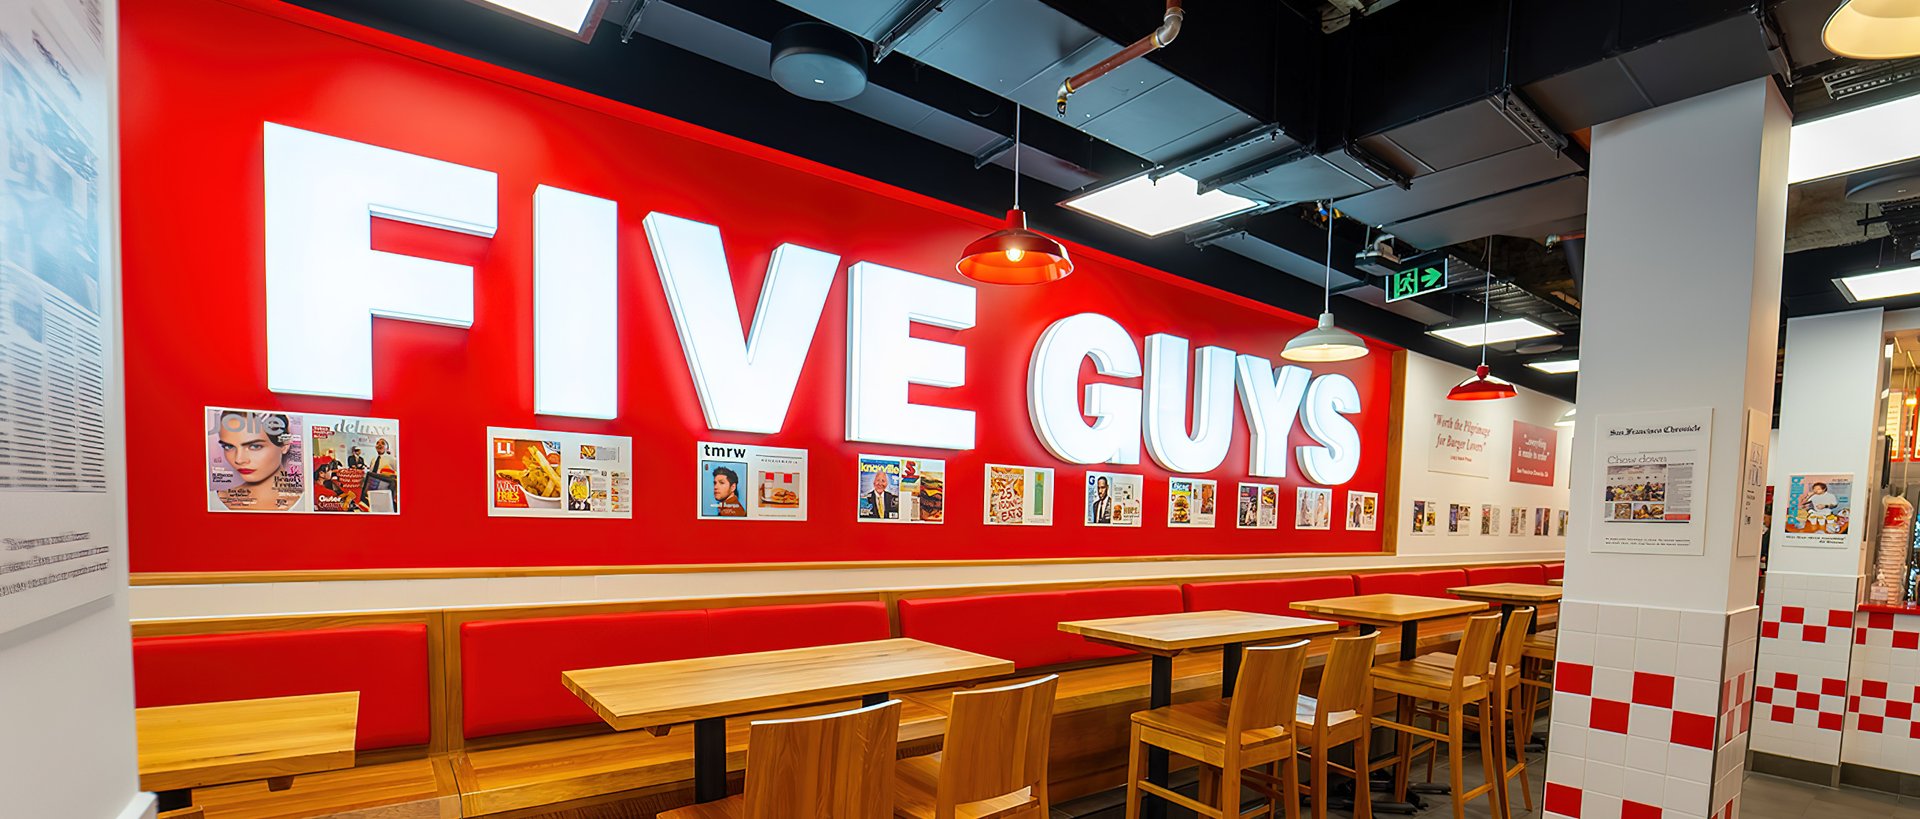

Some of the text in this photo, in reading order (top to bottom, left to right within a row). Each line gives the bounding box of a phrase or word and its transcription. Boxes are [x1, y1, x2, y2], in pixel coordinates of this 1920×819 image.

[263, 121, 976, 450] FIVE
[1027, 312, 1361, 485] GUYS
[334, 419, 391, 436] deluxe
[1624, 427, 1662, 436] Francisco
[1663, 424, 1701, 433] Chronicle
[704, 444, 746, 458] tmrw
[1607, 454, 1667, 464] Chow down
[998, 487, 1013, 500] 25
[1001, 507, 1023, 522] EATS
